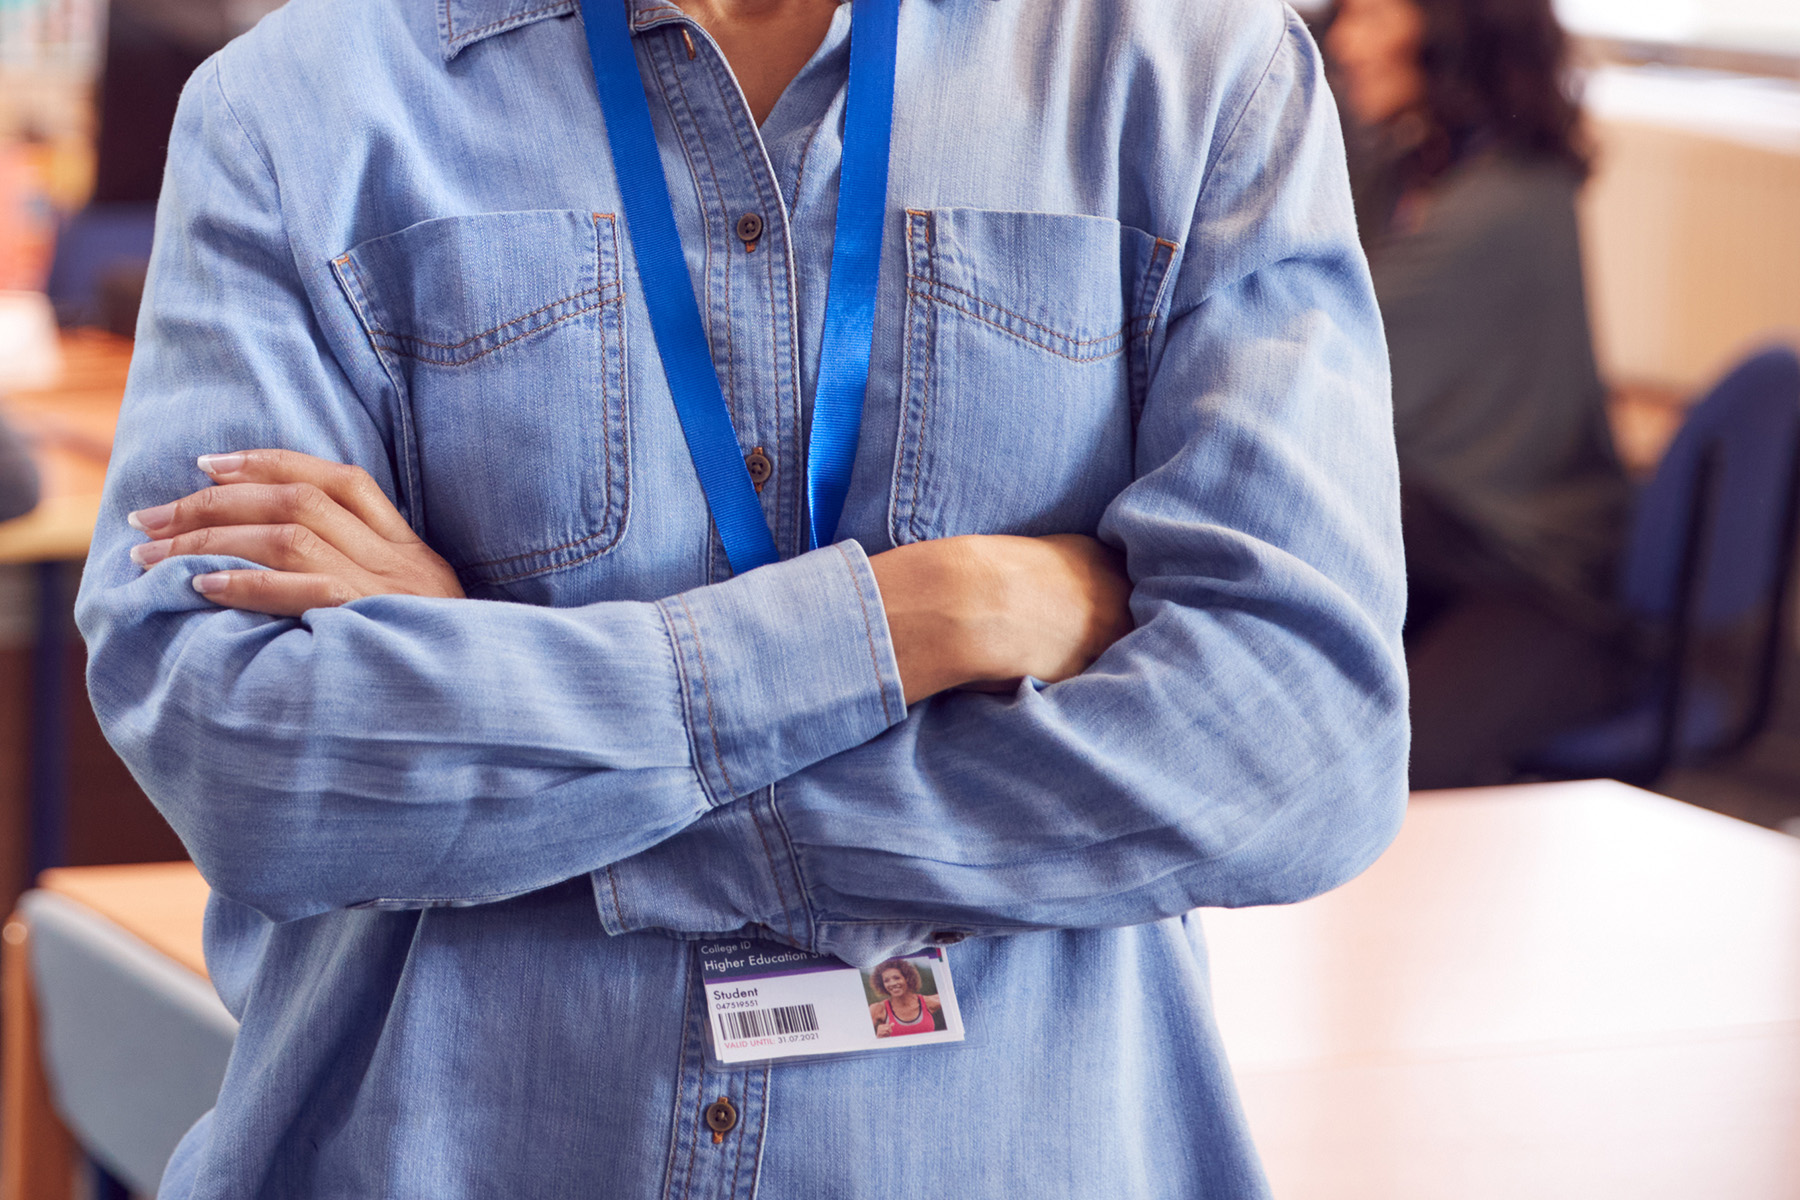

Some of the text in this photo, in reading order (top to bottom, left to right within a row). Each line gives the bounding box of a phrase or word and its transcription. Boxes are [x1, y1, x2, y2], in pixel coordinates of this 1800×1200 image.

[701, 941, 751, 955] College ID
[704, 957, 745, 972] Higher
[748, 951, 808, 966] Education
[713, 988, 758, 1000] Student
[724, 1033, 819, 1049] VALID UNTIL: 31.07.2021
